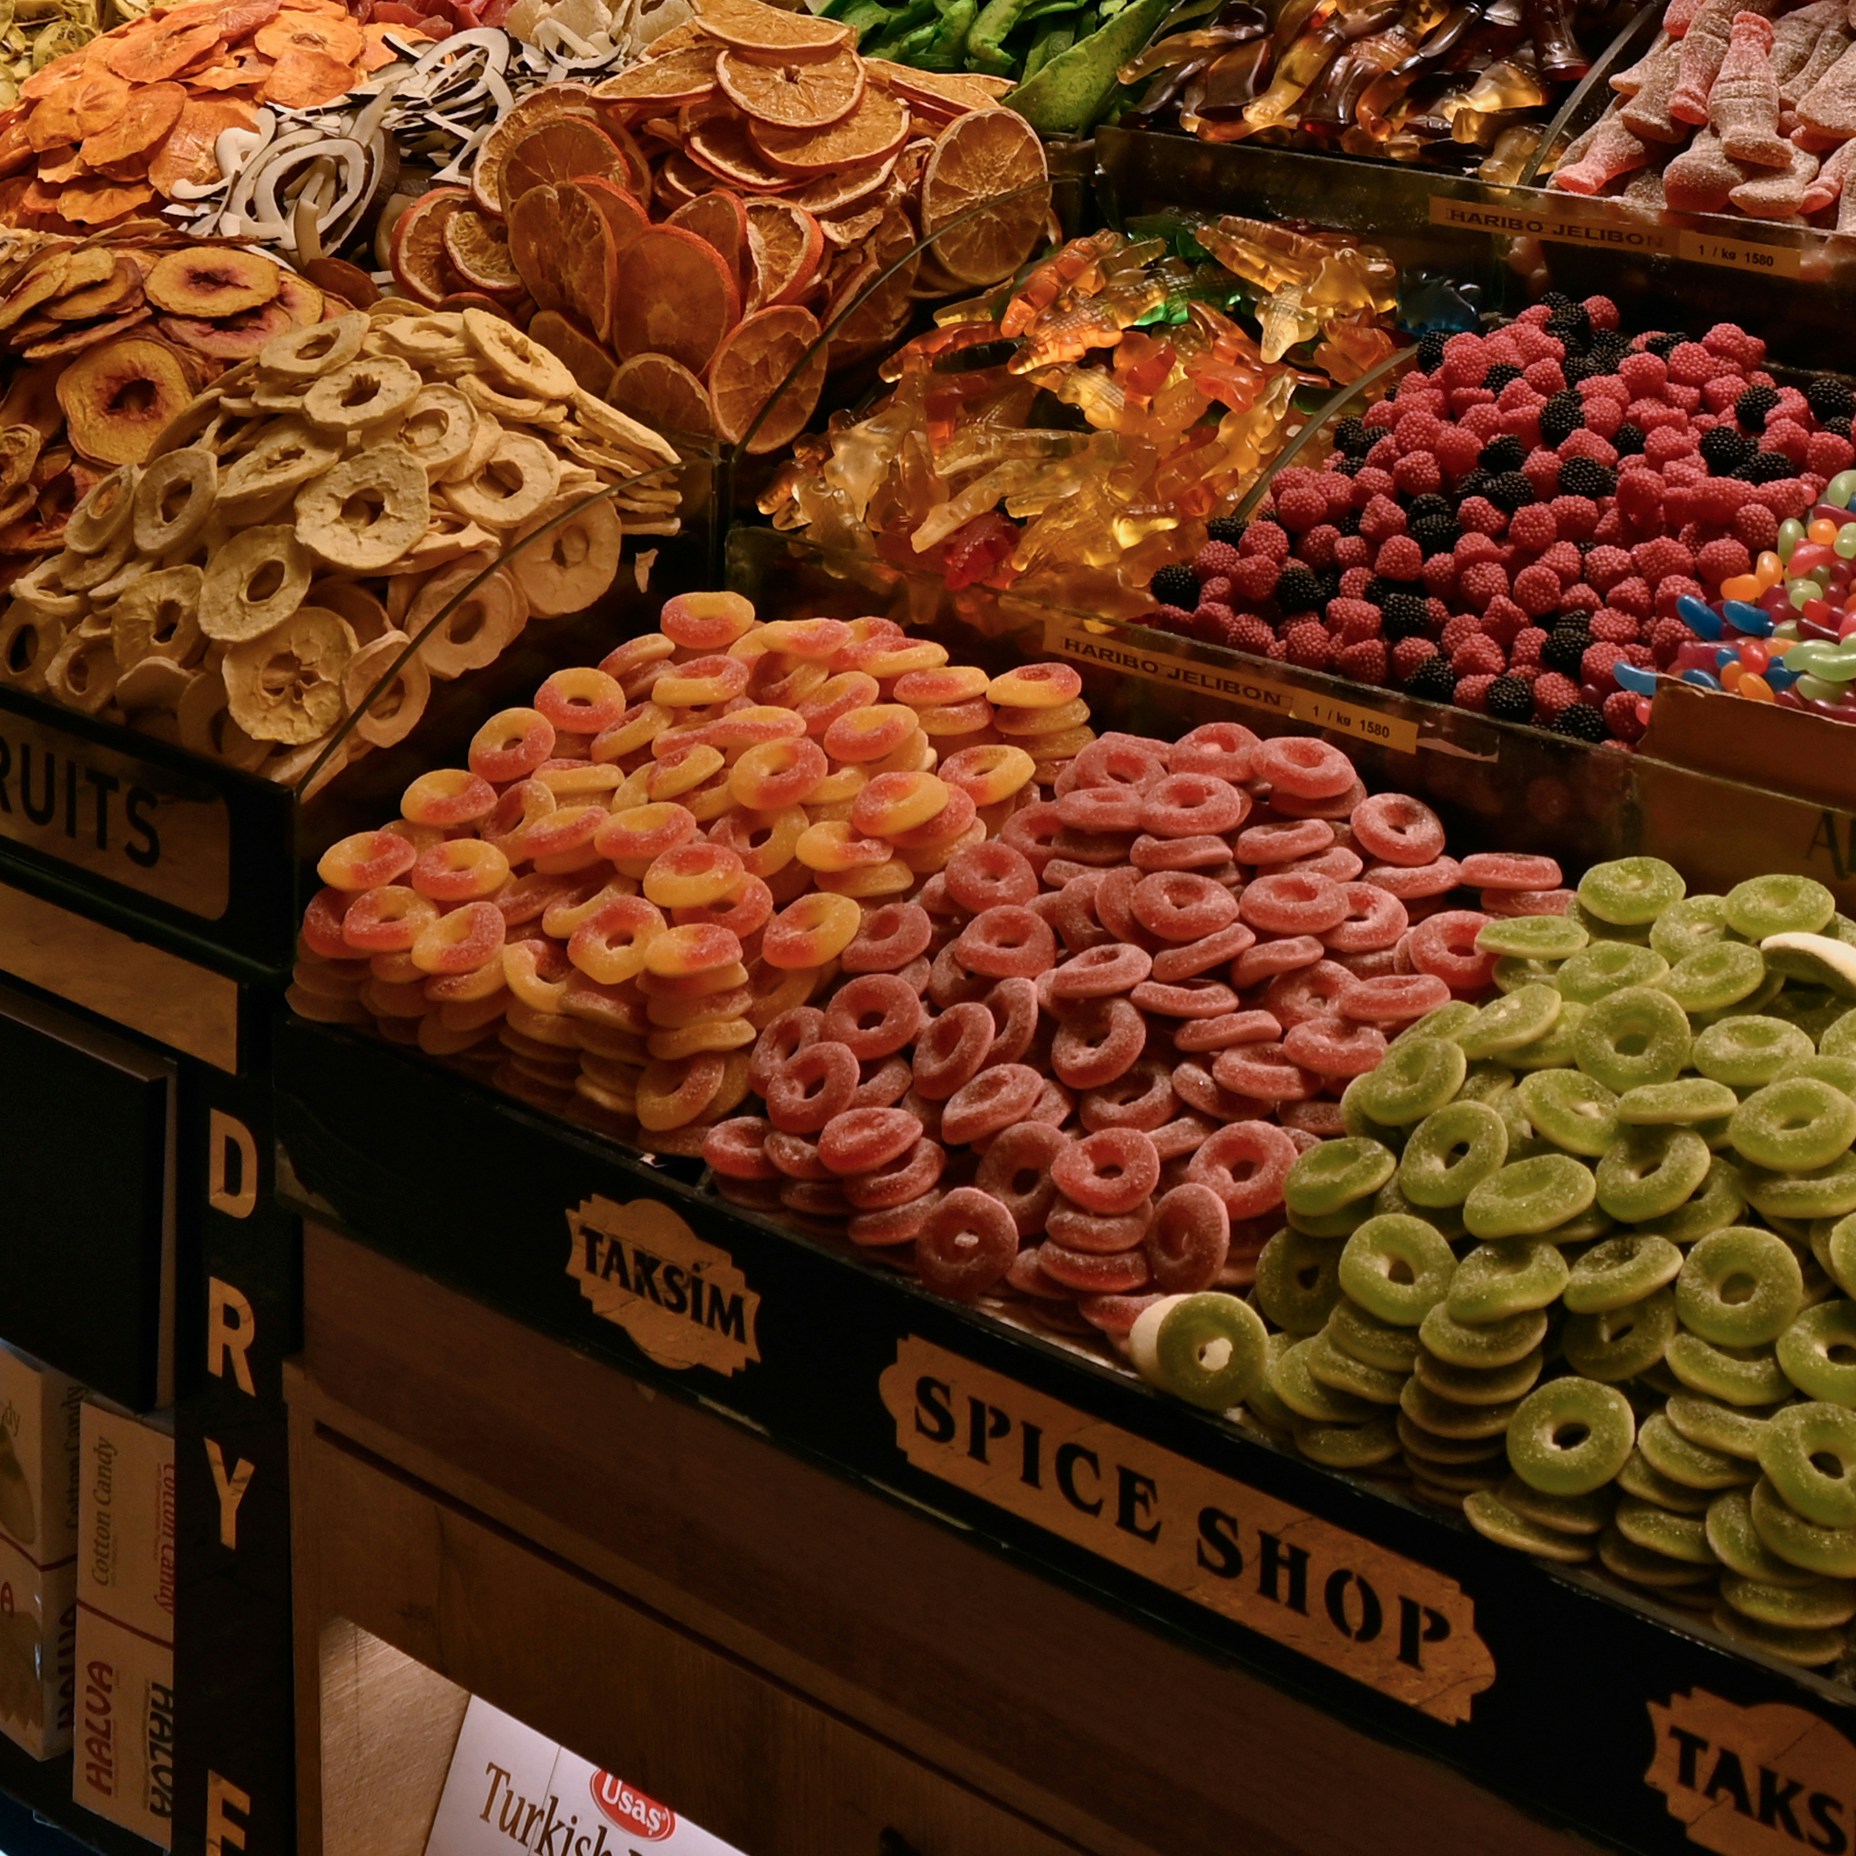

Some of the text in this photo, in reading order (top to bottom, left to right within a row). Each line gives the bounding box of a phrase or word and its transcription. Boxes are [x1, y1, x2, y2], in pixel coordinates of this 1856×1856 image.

[1448, 207, 1775, 269] HARIBO 1 kg 1580
[1063, 635, 1391, 738] HARIBO JELIBON 1580
[577, 1223, 747, 1345] TAKSİM
[91, 1435, 118, 1588] Cotton Candy
[913, 1372, 1455, 1676] SPICE SHOP
[85, 1659, 114, 1797] HALVA
